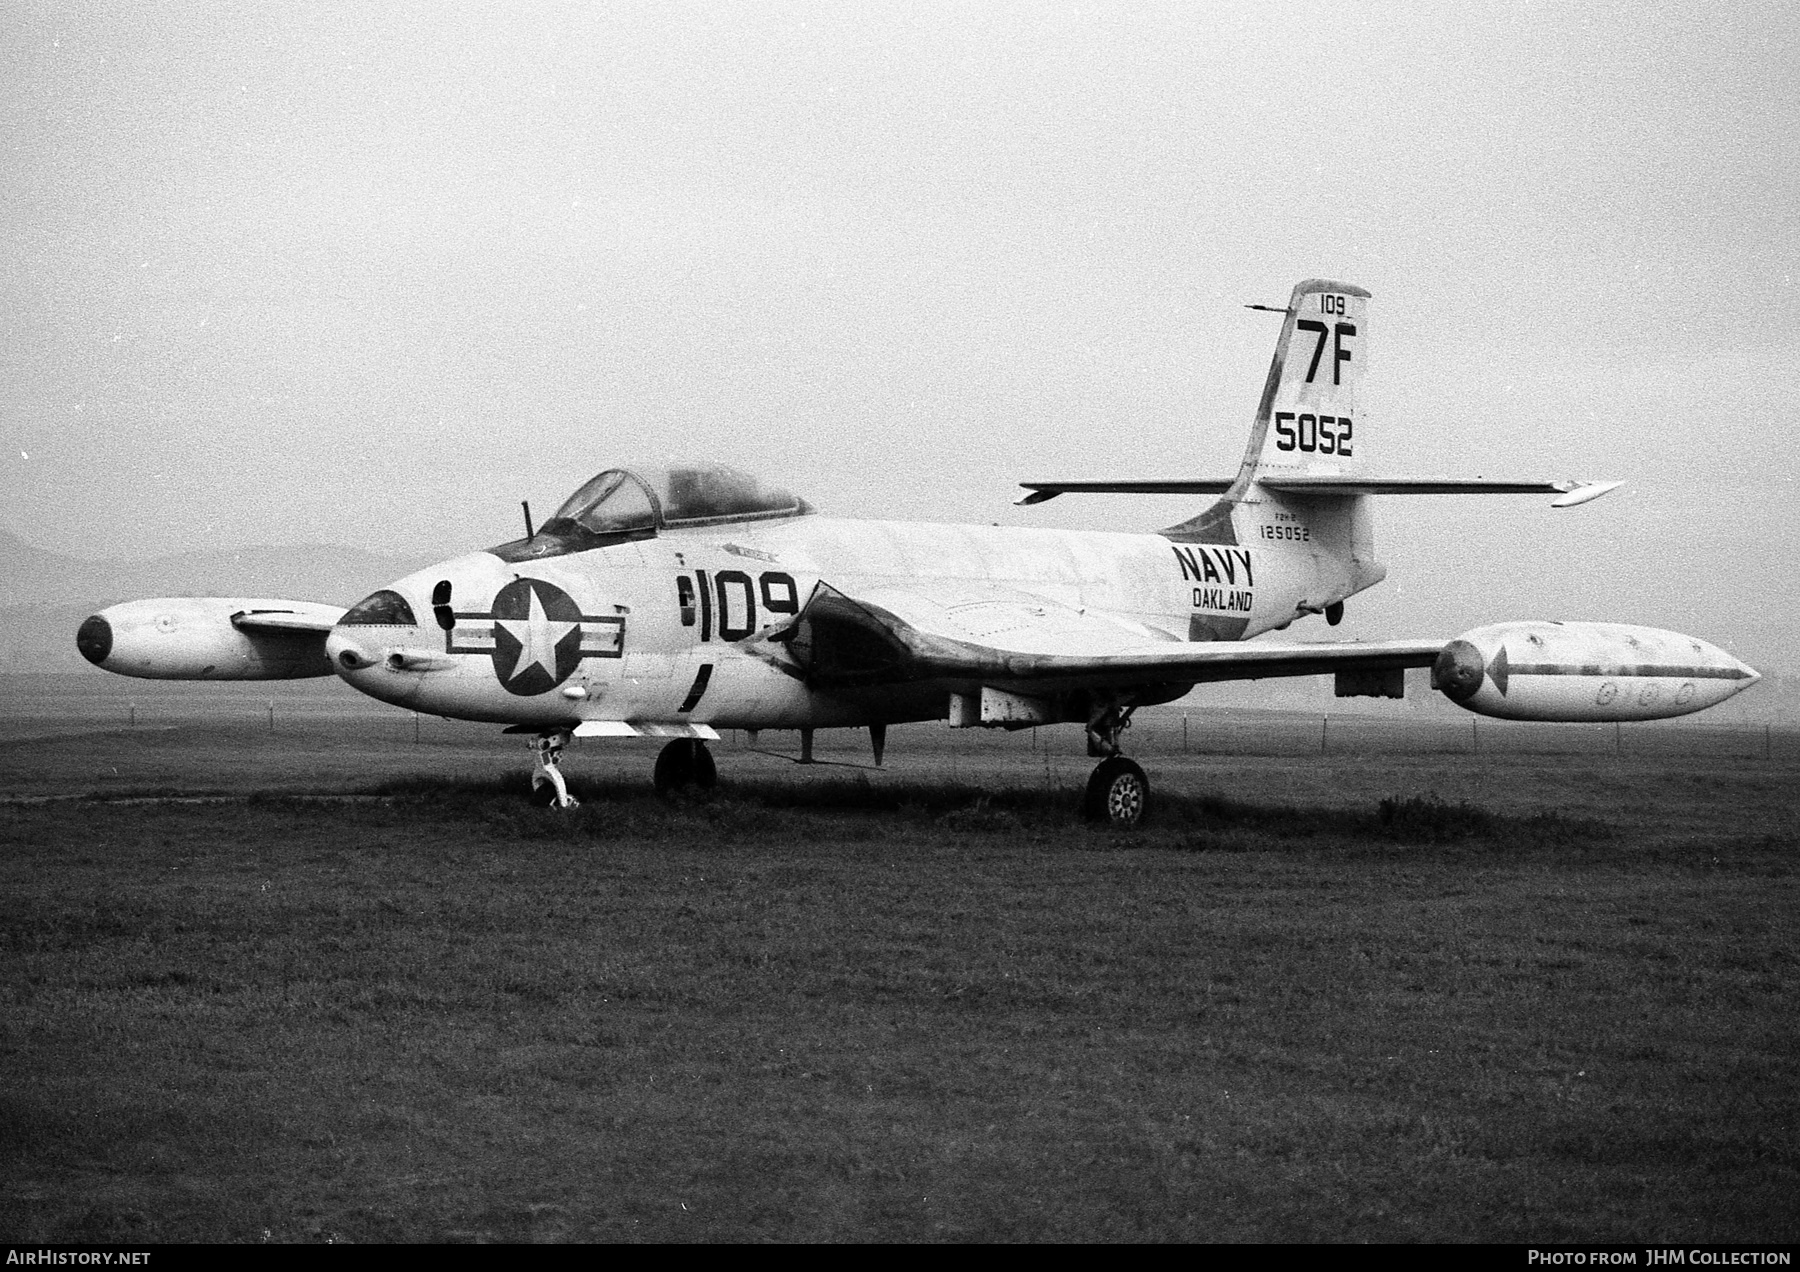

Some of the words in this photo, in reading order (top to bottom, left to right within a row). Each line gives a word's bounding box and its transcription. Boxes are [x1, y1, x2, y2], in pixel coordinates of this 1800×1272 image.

[1321, 294, 1345, 315] 109
[1297, 319, 1356, 385] 7F
[1275, 412, 1353, 457] 5052
[1260, 525, 1310, 542] 125052
[1172, 546, 1253, 587] NAVY
[695, 569, 799, 642] 109
[1193, 588, 1253, 612] OAKLAND
